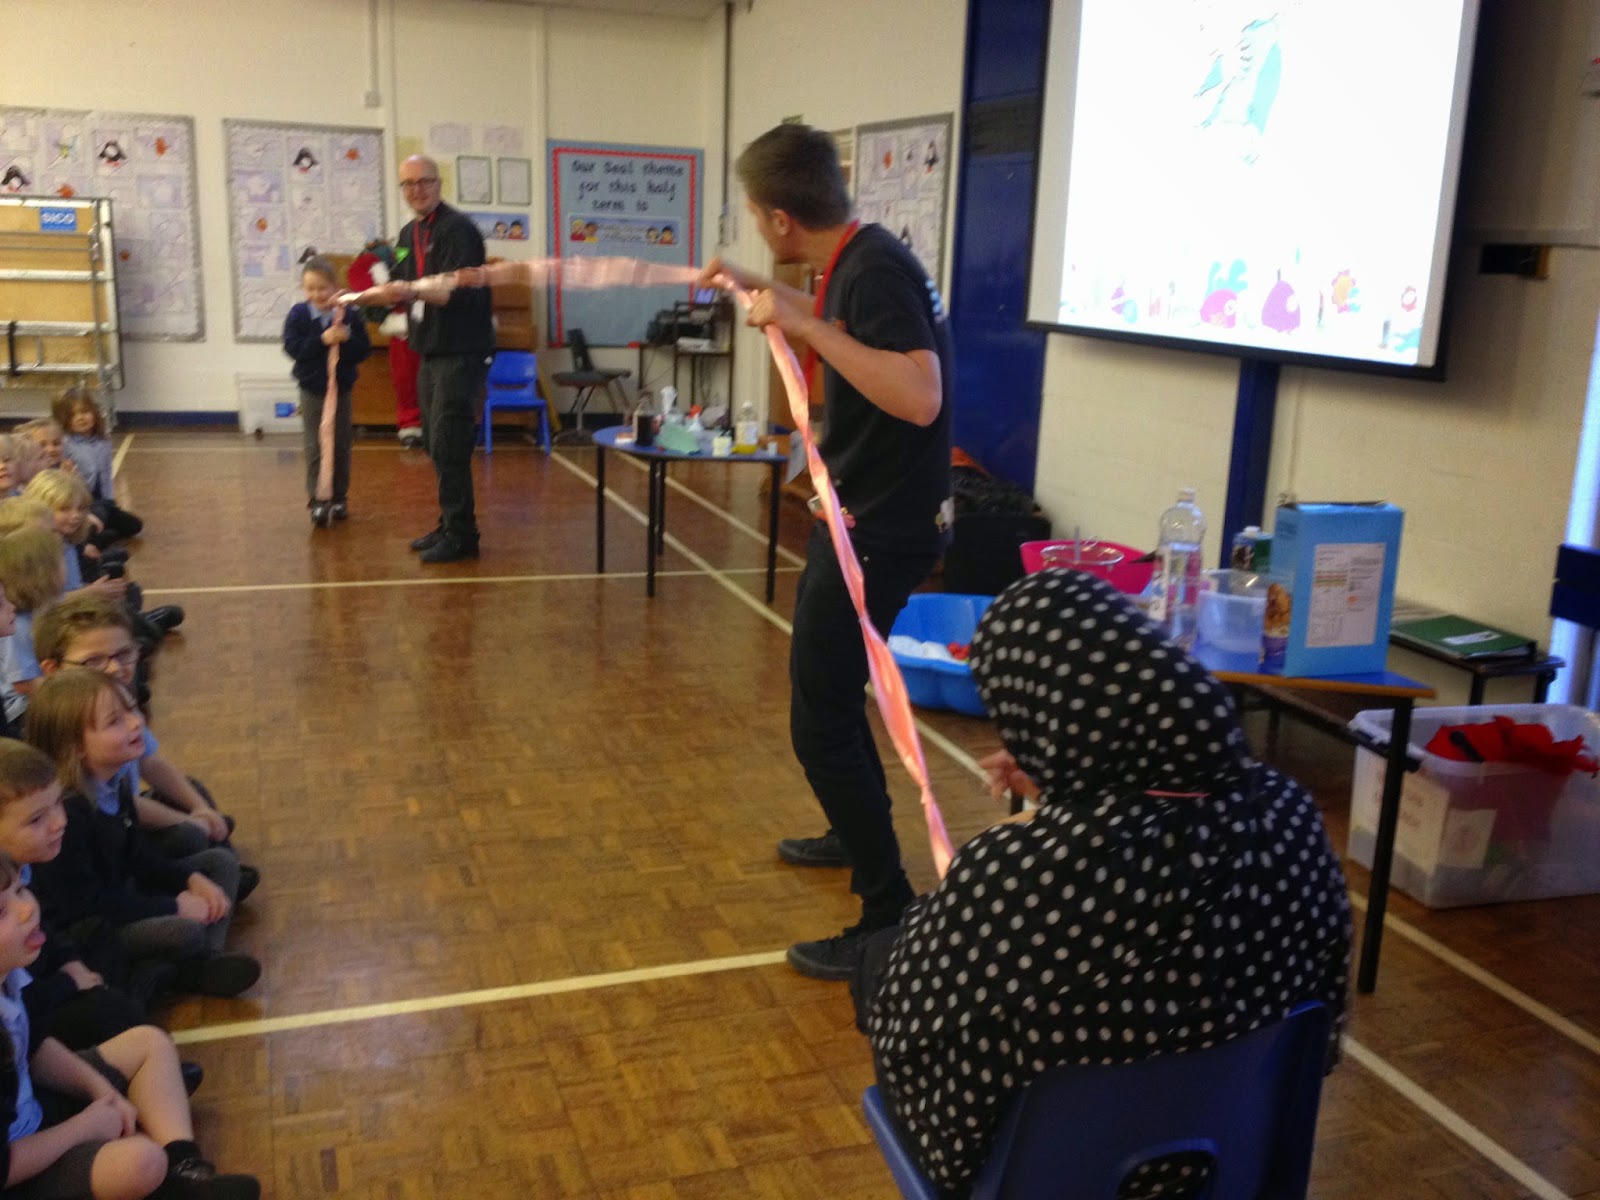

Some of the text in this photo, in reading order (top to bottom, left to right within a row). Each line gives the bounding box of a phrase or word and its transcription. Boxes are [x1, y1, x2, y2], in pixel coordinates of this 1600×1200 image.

[571, 159, 597, 173] Our
[642, 161, 684, 177] theme
[578, 178, 677, 202] for this half
[592, 199, 649, 212] term is
